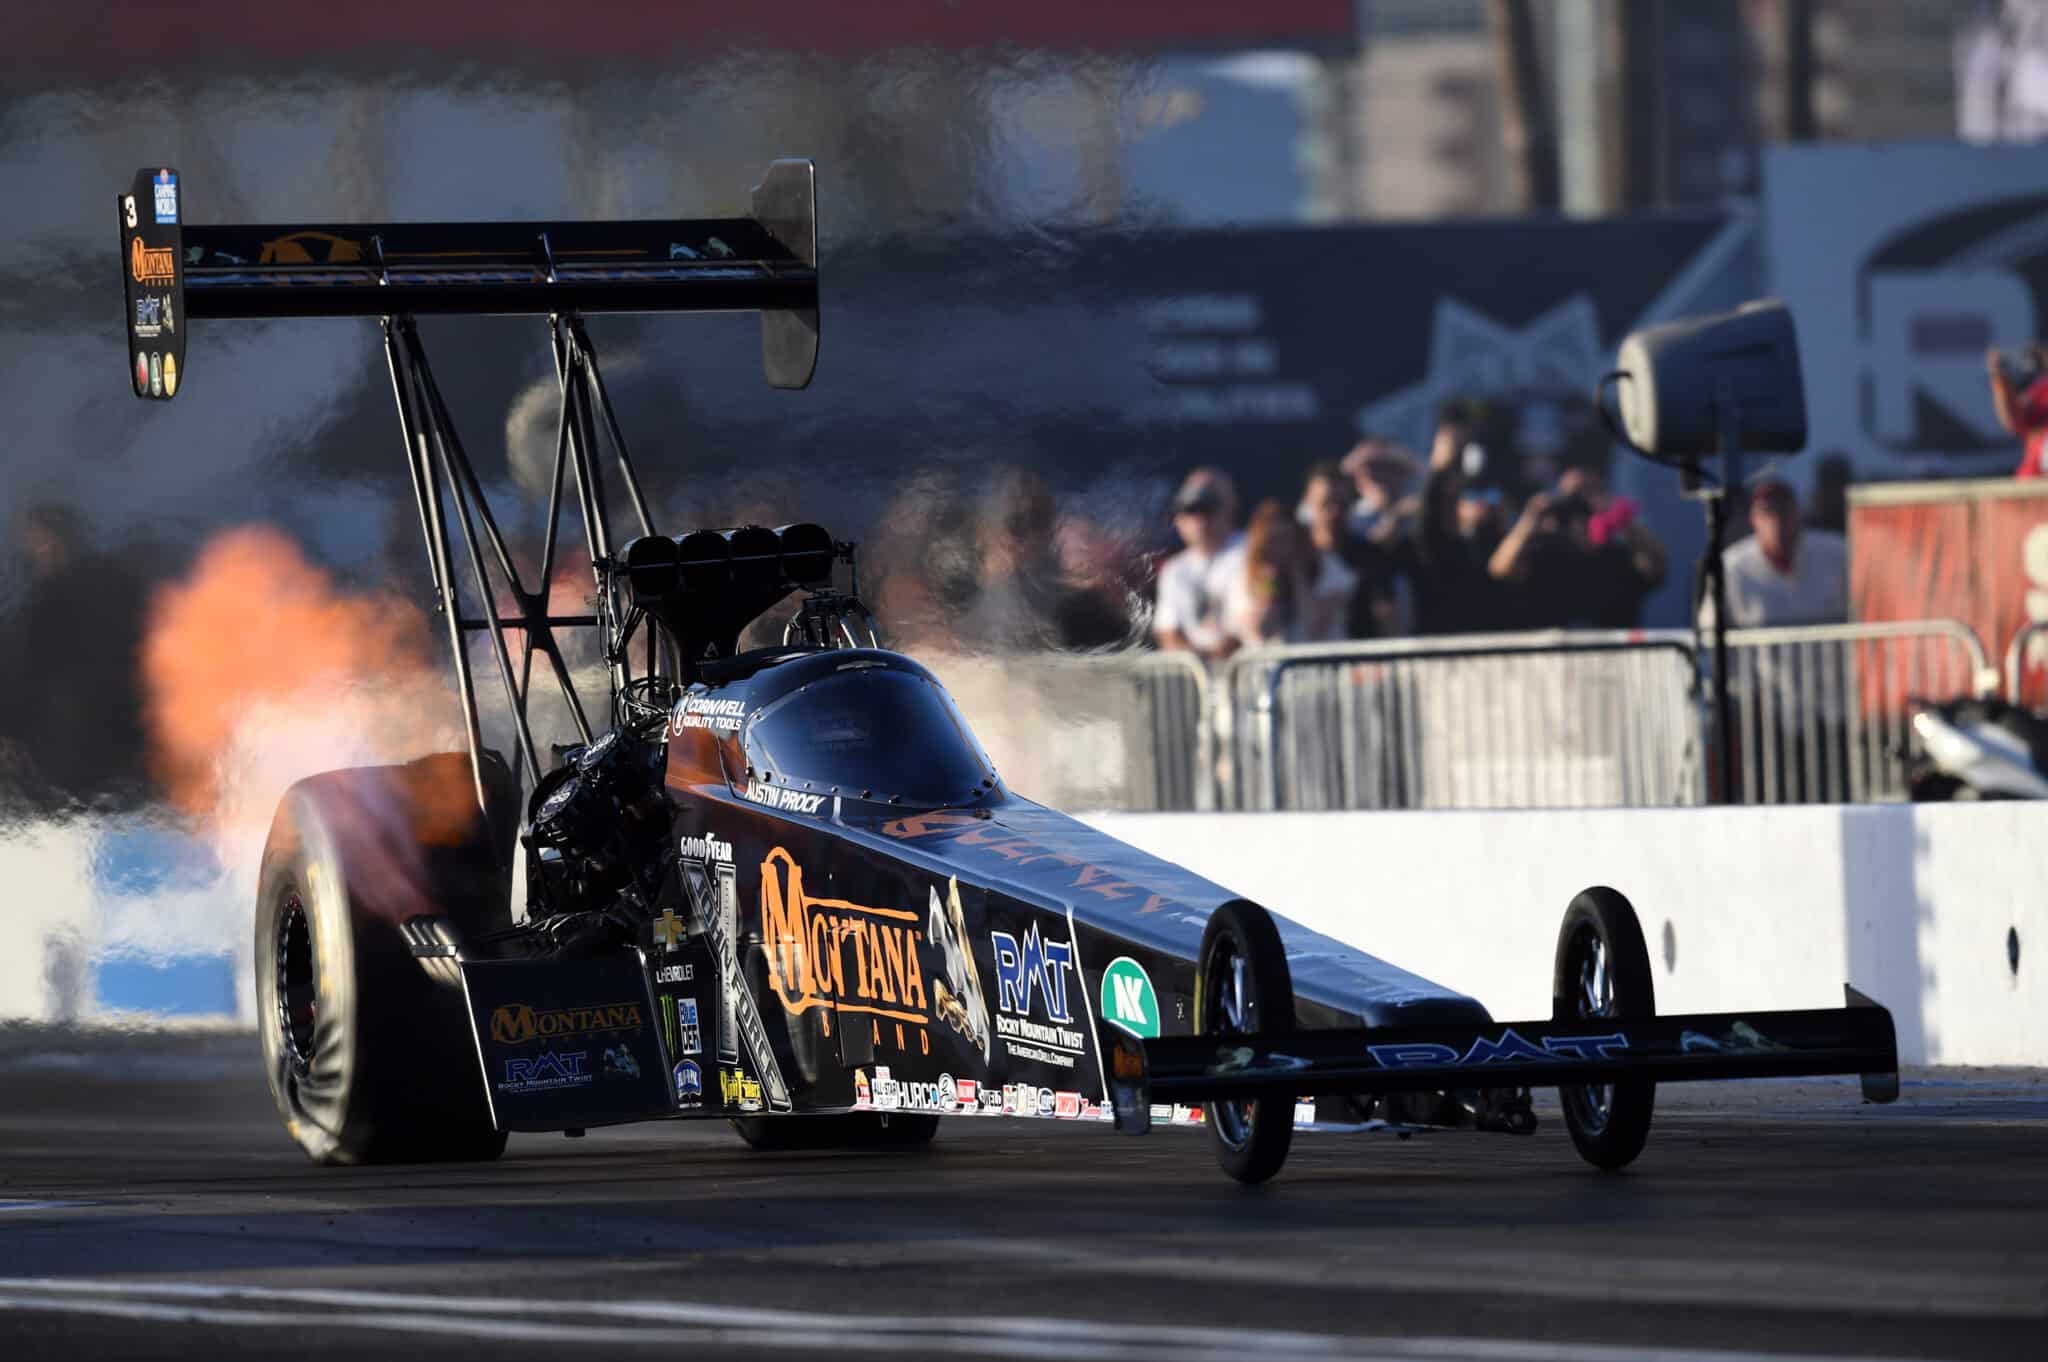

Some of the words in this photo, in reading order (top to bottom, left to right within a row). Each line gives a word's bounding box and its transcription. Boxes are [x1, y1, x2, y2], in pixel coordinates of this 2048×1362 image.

[125, 195, 138, 228] 3
[684, 716, 713, 729] QUALITY
[716, 716, 743, 731] TOOLS
[688, 698, 746, 717] CORNWELL
[744, 780, 780, 807] AUSTIN
[779, 791, 827, 814] PROCK
[991, 920, 1073, 1024] RMT
[491, 1003, 641, 1044] MONTANA
[820, 1010, 929, 1056] BAND
[995, 1013, 1020, 1035] ROCKY
[1020, 1018, 1057, 1045] MOUNTAIN
[1056, 1026, 1084, 1049] TWIST
[505, 1050, 588, 1083] RMT
[897, 1081, 939, 1110] HURCO
